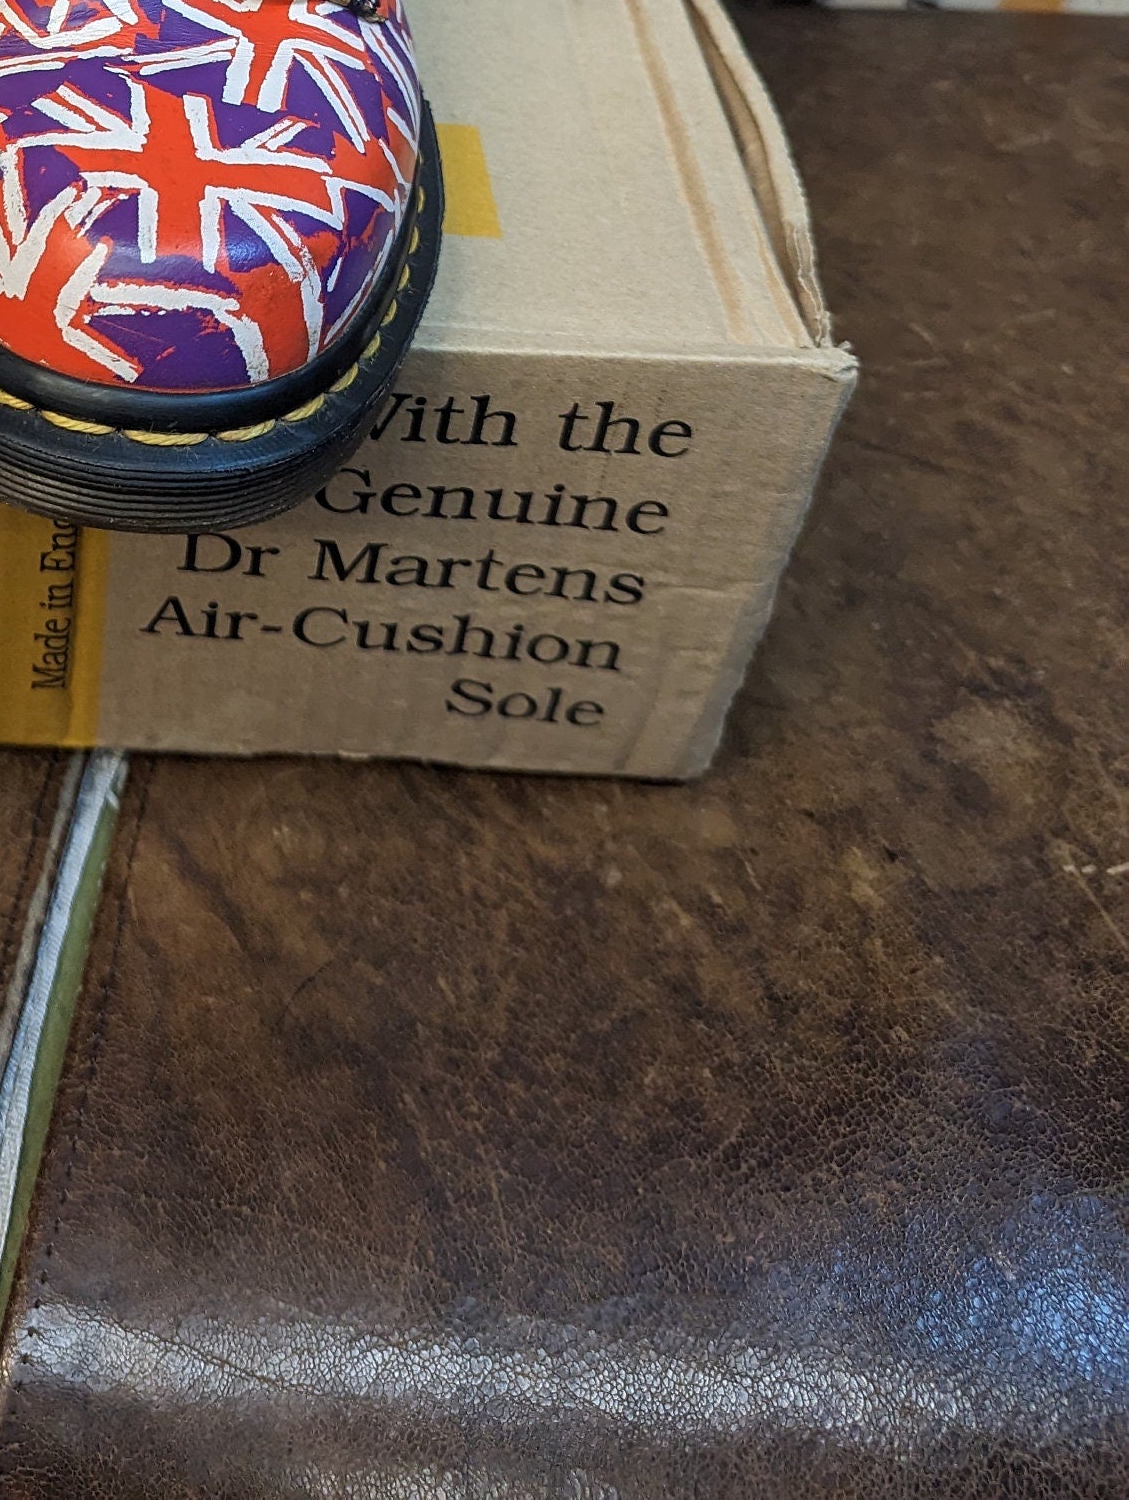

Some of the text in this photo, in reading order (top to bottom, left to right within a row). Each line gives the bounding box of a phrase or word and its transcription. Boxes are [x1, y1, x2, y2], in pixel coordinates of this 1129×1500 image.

[558, 400, 693, 458] the
[315, 466, 669, 536] Genuine
[39, 577, 73, 611] in
[176, 532, 646, 606] Dr Martens
[31, 617, 71, 690] Made
[139, 595, 623, 671] Air-Cushion
[445, 677, 606, 728] Sole
